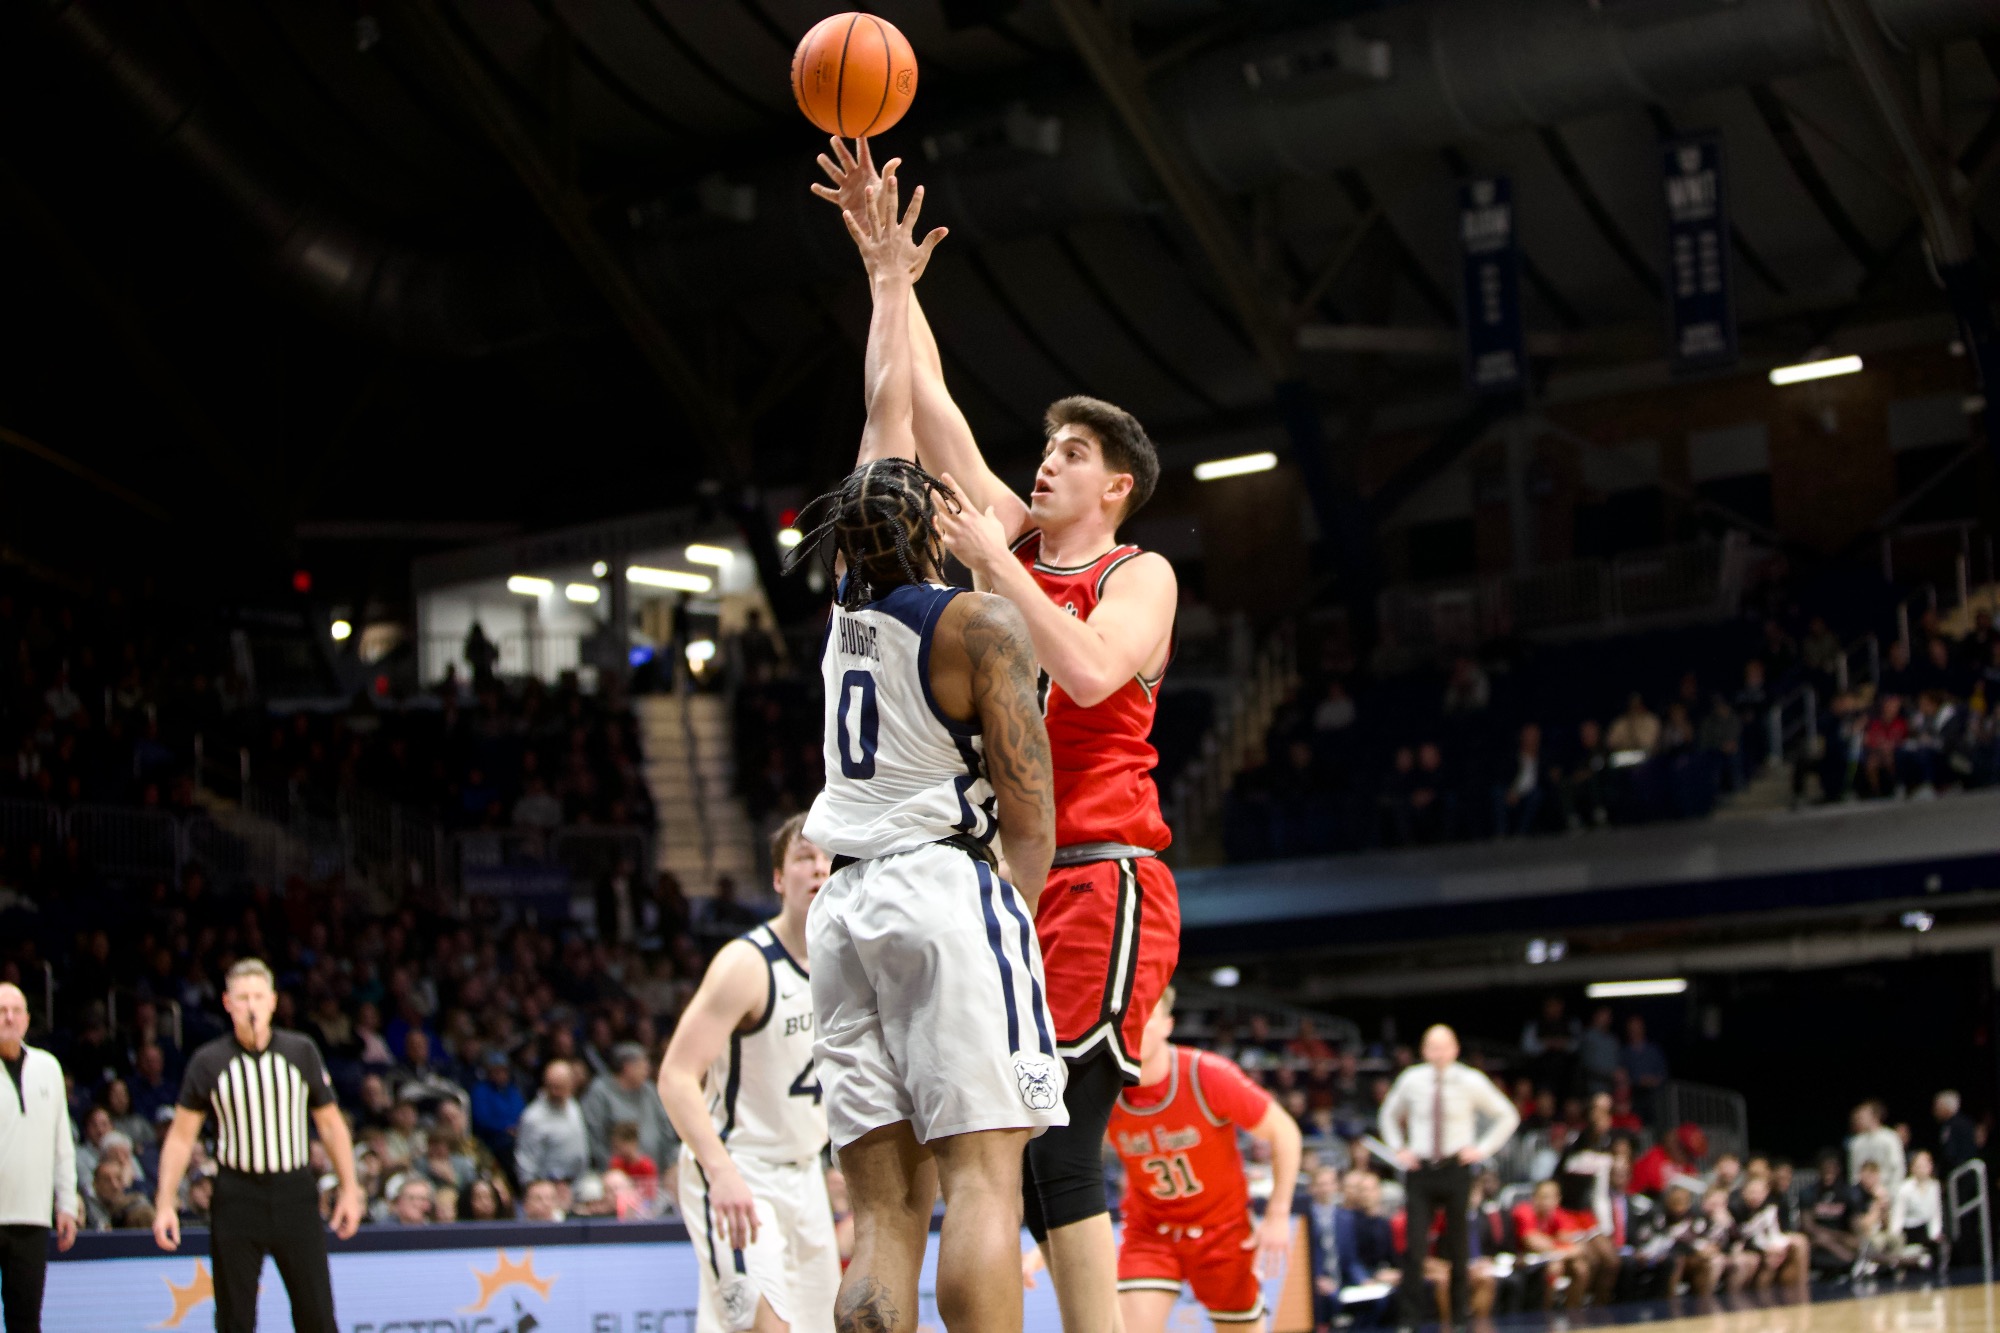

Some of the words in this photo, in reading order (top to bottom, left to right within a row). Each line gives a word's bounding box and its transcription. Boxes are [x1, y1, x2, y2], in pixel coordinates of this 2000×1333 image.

[837, 669, 879, 780] 0
[788, 1057, 823, 1106] 4
[1142, 1153, 1203, 1199] 31
